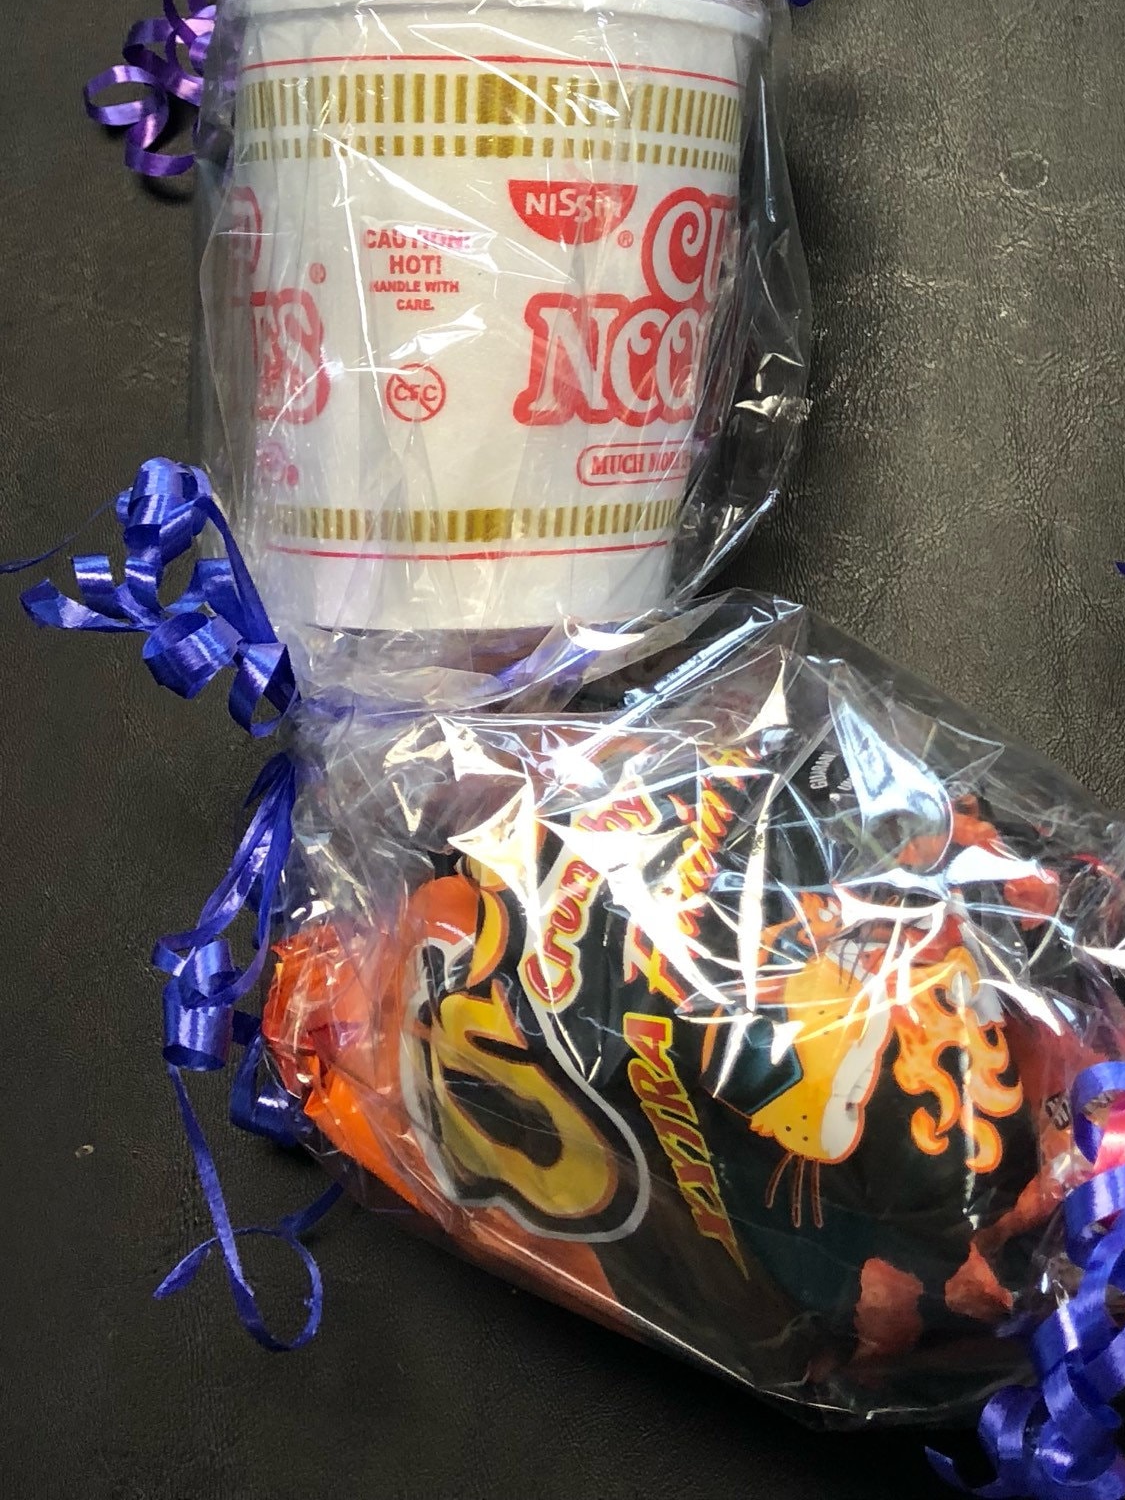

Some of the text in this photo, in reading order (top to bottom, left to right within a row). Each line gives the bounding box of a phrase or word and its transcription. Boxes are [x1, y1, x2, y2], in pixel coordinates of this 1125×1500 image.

[525, 187, 622, 224] NISSIN
[389, 255, 442, 275] HOT!
[369, 280, 460, 294] HANDLE WITH
[396, 299, 435, 312] CARE.
[394, 384, 438, 401] CFC
[591, 454, 644, 476] MUCH
[523, 777, 653, 1004] Crunhy
